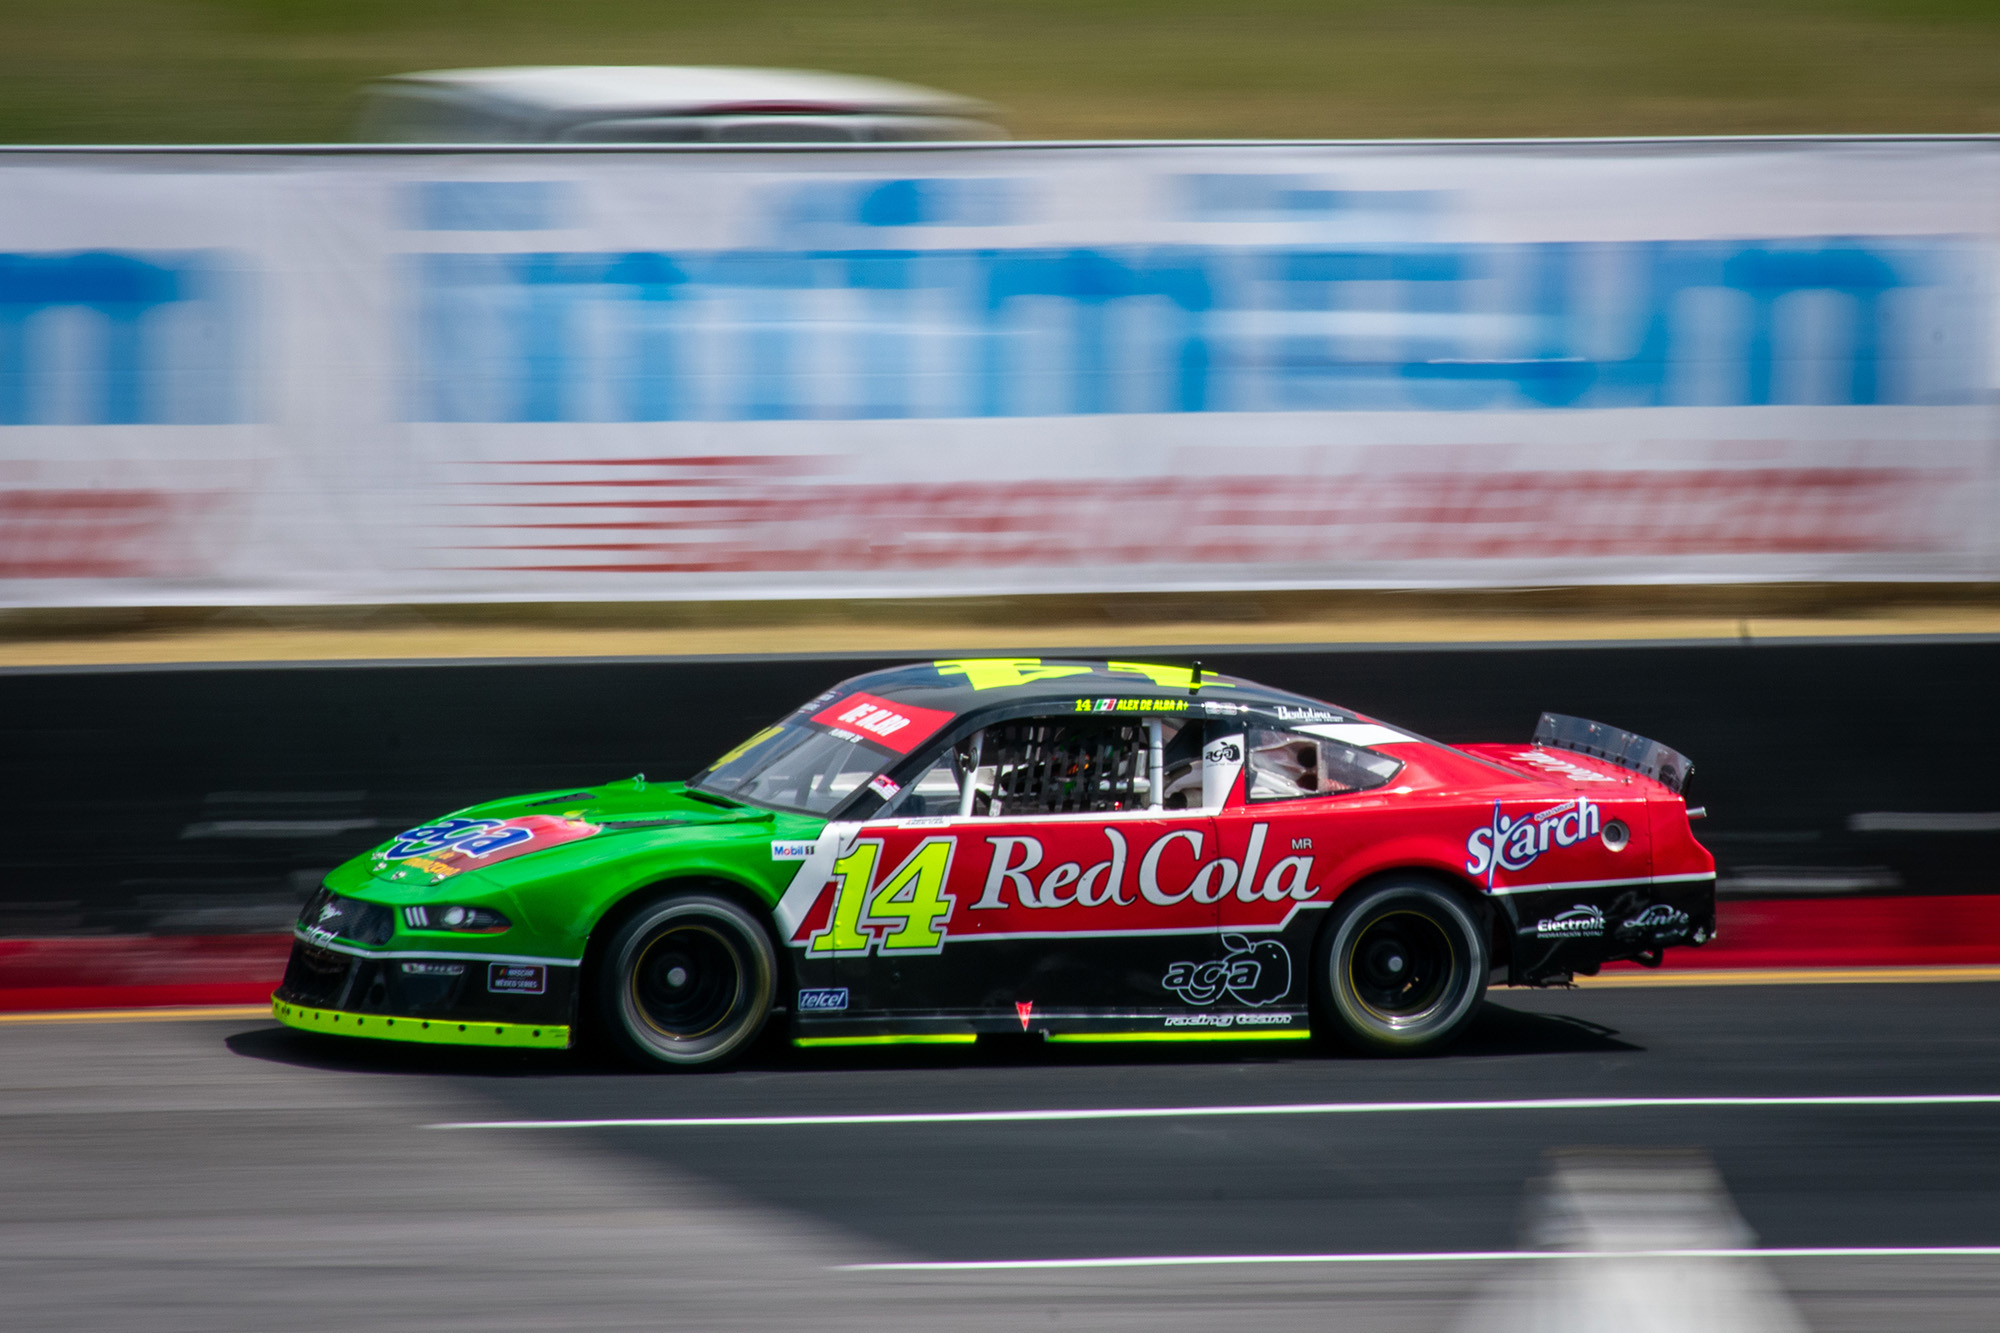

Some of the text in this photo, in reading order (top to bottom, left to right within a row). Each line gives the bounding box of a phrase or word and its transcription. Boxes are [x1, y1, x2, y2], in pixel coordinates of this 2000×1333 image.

[1075, 698, 1091, 711] 14
[1116, 699, 1139, 711] ALEX
[1140, 699, 1153, 711] DE
[1153, 699, 1175, 711] ALBA
[1205, 750, 1233, 763] aga
[774, 846, 803, 855] Mobil
[1291, 839, 1312, 850] MR
[804, 836, 958, 959] 14
[1162, 961, 1261, 1005] aga
[801, 991, 845, 1007] telcel
[1164, 1014, 1292, 1027] racing team
